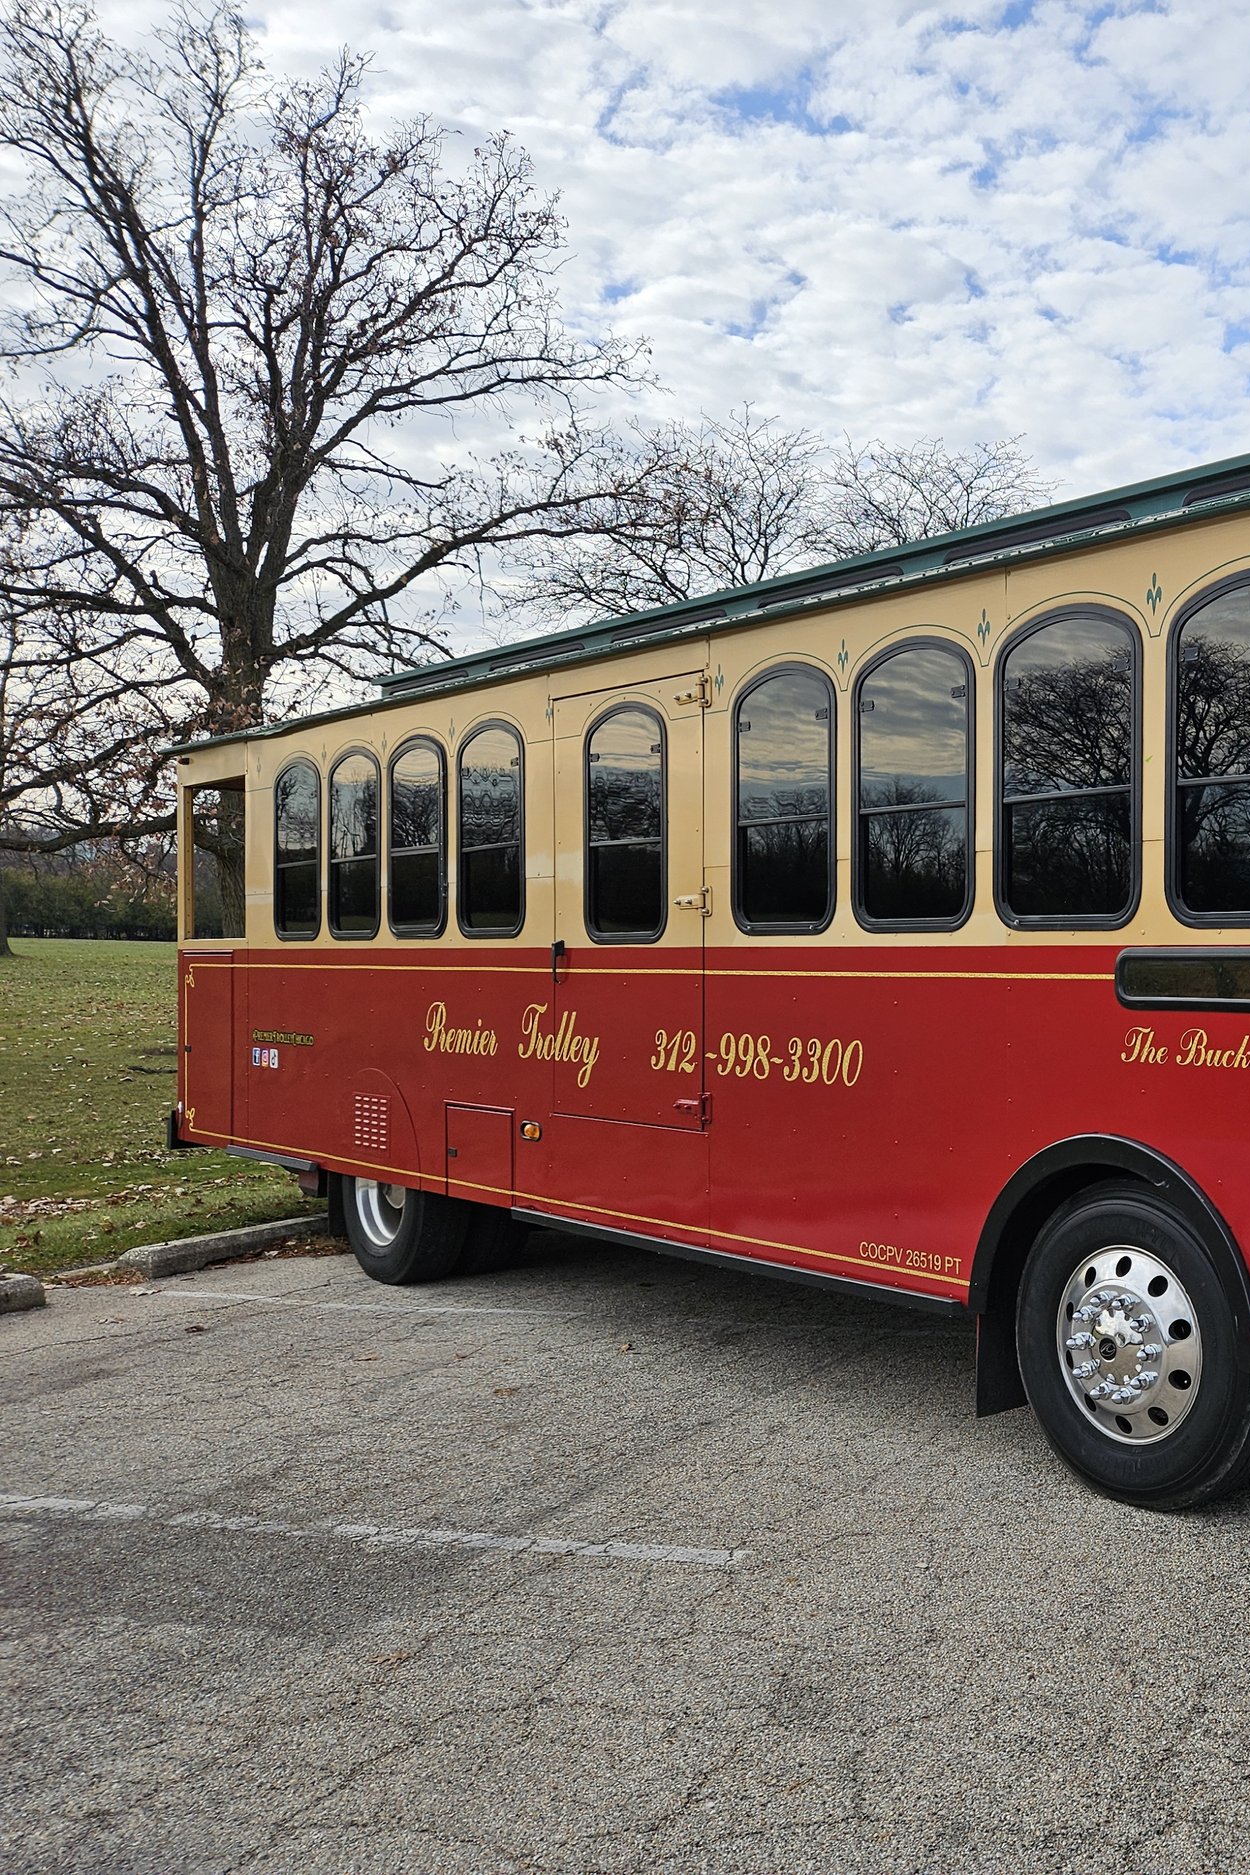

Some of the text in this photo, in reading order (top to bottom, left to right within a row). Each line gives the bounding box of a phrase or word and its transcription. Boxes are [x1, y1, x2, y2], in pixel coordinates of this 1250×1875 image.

[423, 1001, 498, 1056] Premier
[518, 1002, 600, 1088] Trolley
[1120, 1026, 1168, 1064] The
[859, 1241, 962, 1275] COCPV 26519 PT
